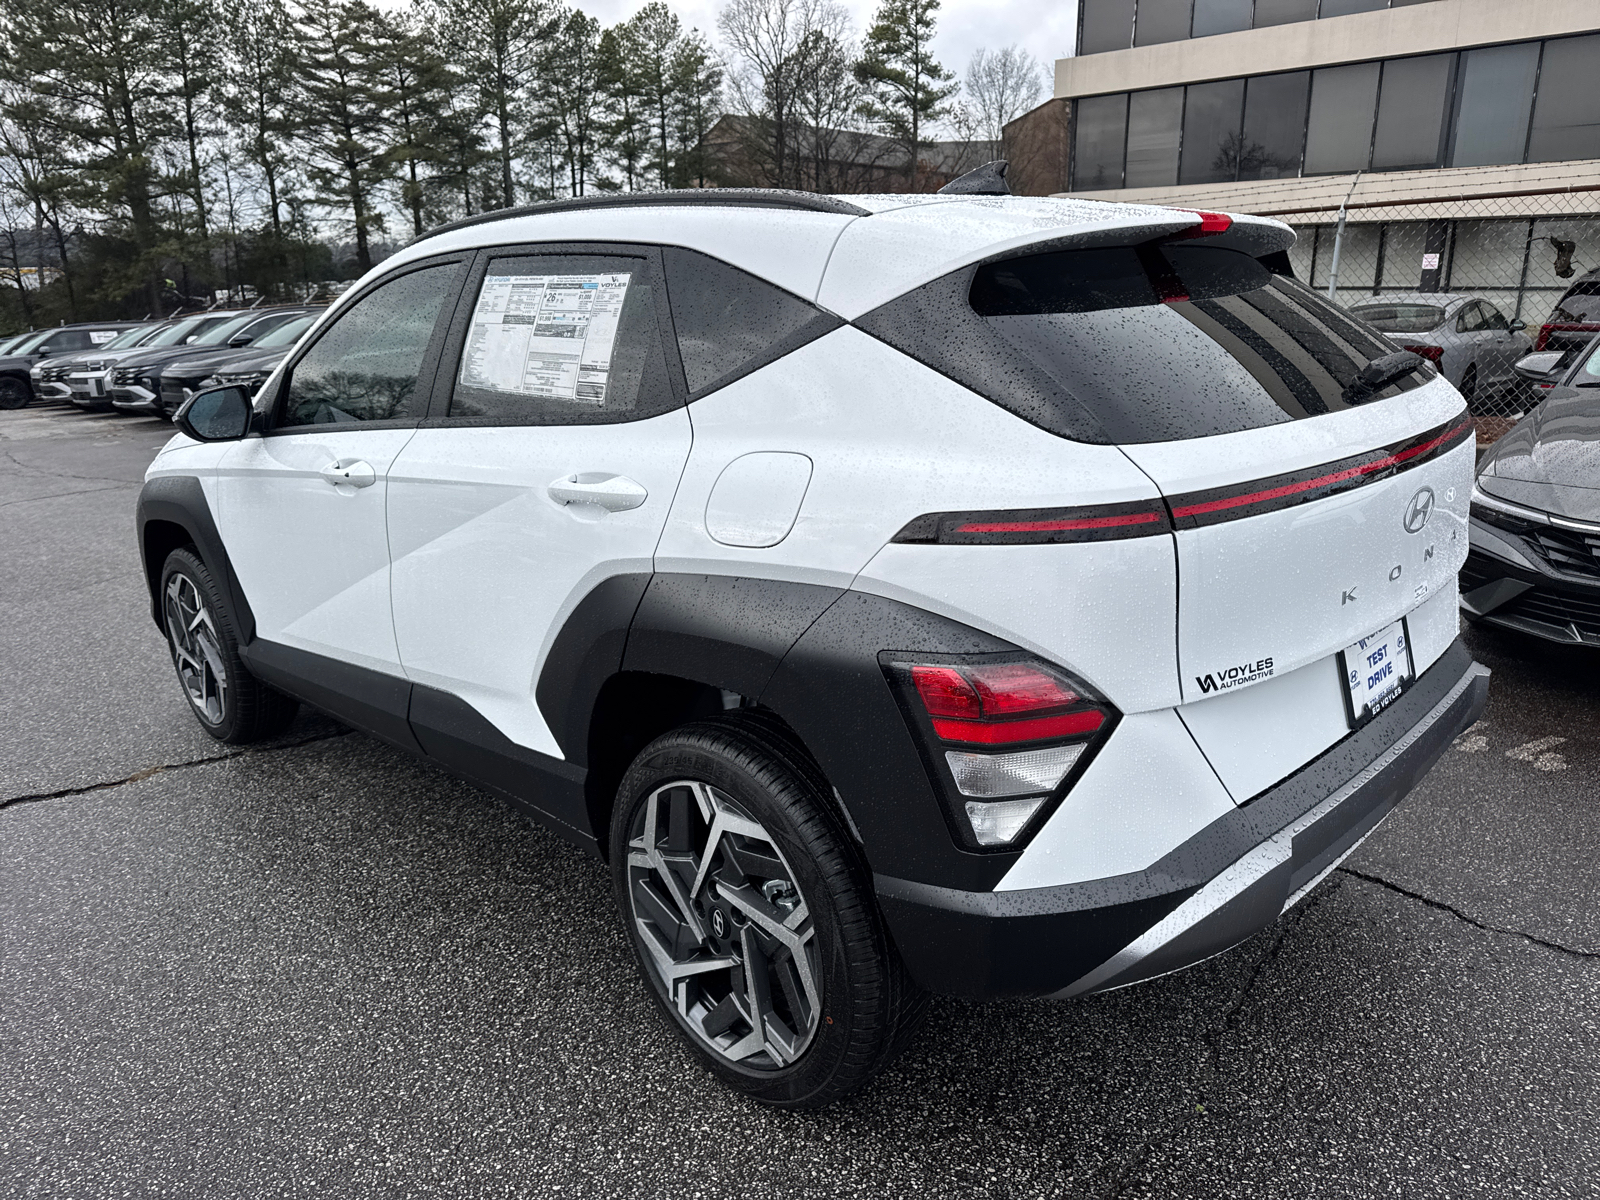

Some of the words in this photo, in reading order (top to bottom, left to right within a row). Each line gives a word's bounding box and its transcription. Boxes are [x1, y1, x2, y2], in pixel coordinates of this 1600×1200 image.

[546, 293, 557, 302] 26
[1366, 643, 1388, 669] TEST
[1216, 657, 1274, 682] VOYLES
[1219, 668, 1274, 690] AUTOMOTIVE
[1367, 661, 1393, 691] DRIVE
[1371, 703, 1381, 715] ED
[1380, 686, 1402, 708] VOYLES
